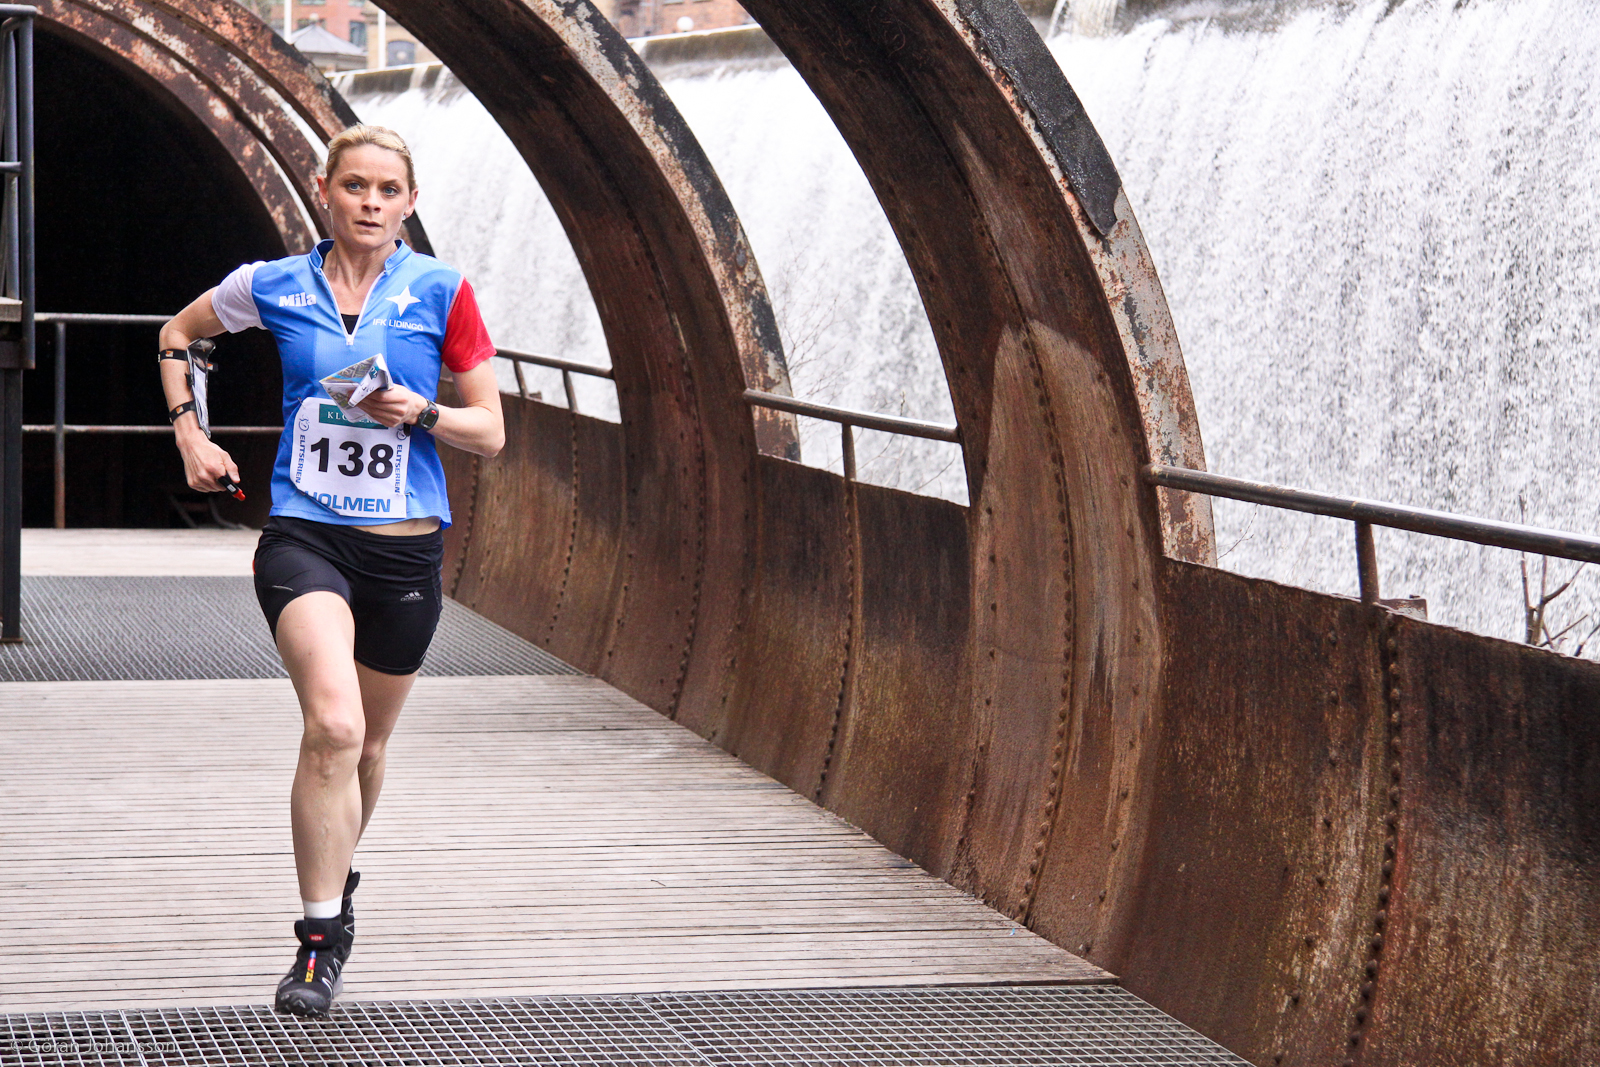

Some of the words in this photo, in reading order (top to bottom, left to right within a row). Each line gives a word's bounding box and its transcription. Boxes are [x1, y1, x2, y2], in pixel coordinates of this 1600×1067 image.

[278, 292, 317, 307] Mila
[372, 318, 387, 327] IFK
[295, 434, 306, 484] ELITSERIEN
[310, 437, 394, 479] 138
[394, 444, 403, 494] ELITSERIEN
